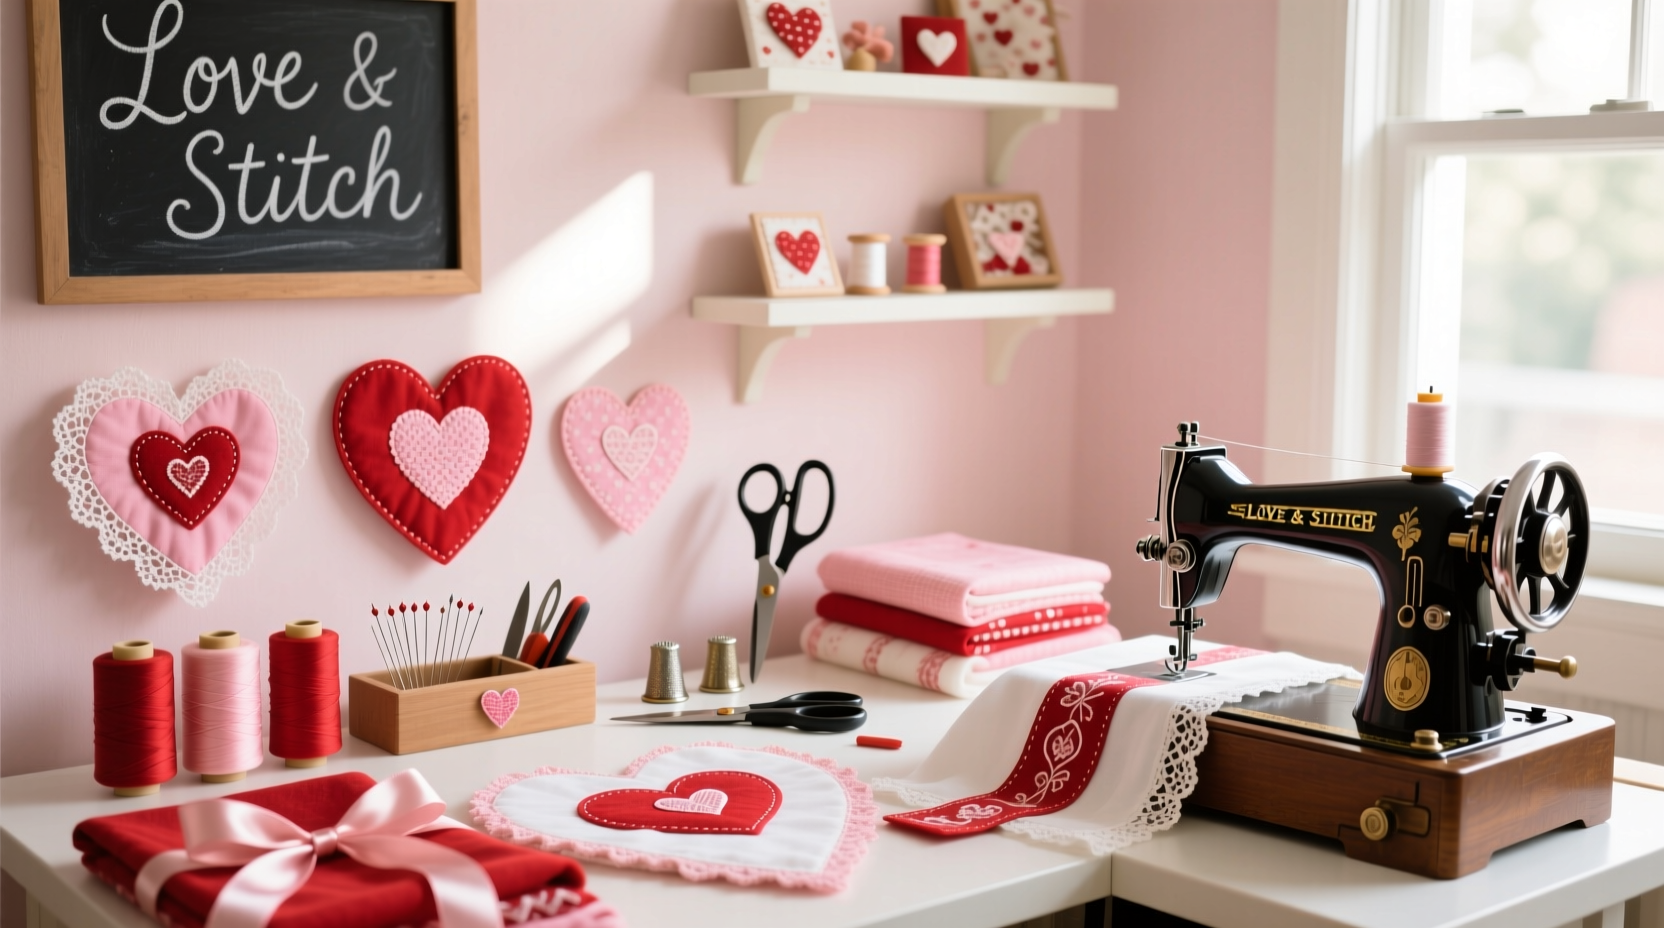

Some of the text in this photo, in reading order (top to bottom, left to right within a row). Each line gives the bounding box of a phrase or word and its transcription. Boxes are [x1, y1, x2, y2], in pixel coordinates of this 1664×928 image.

[100, 0, 397, 130] Love &
[166, 126, 422, 240] Stitch
[1291, 509, 1304, 525] &
